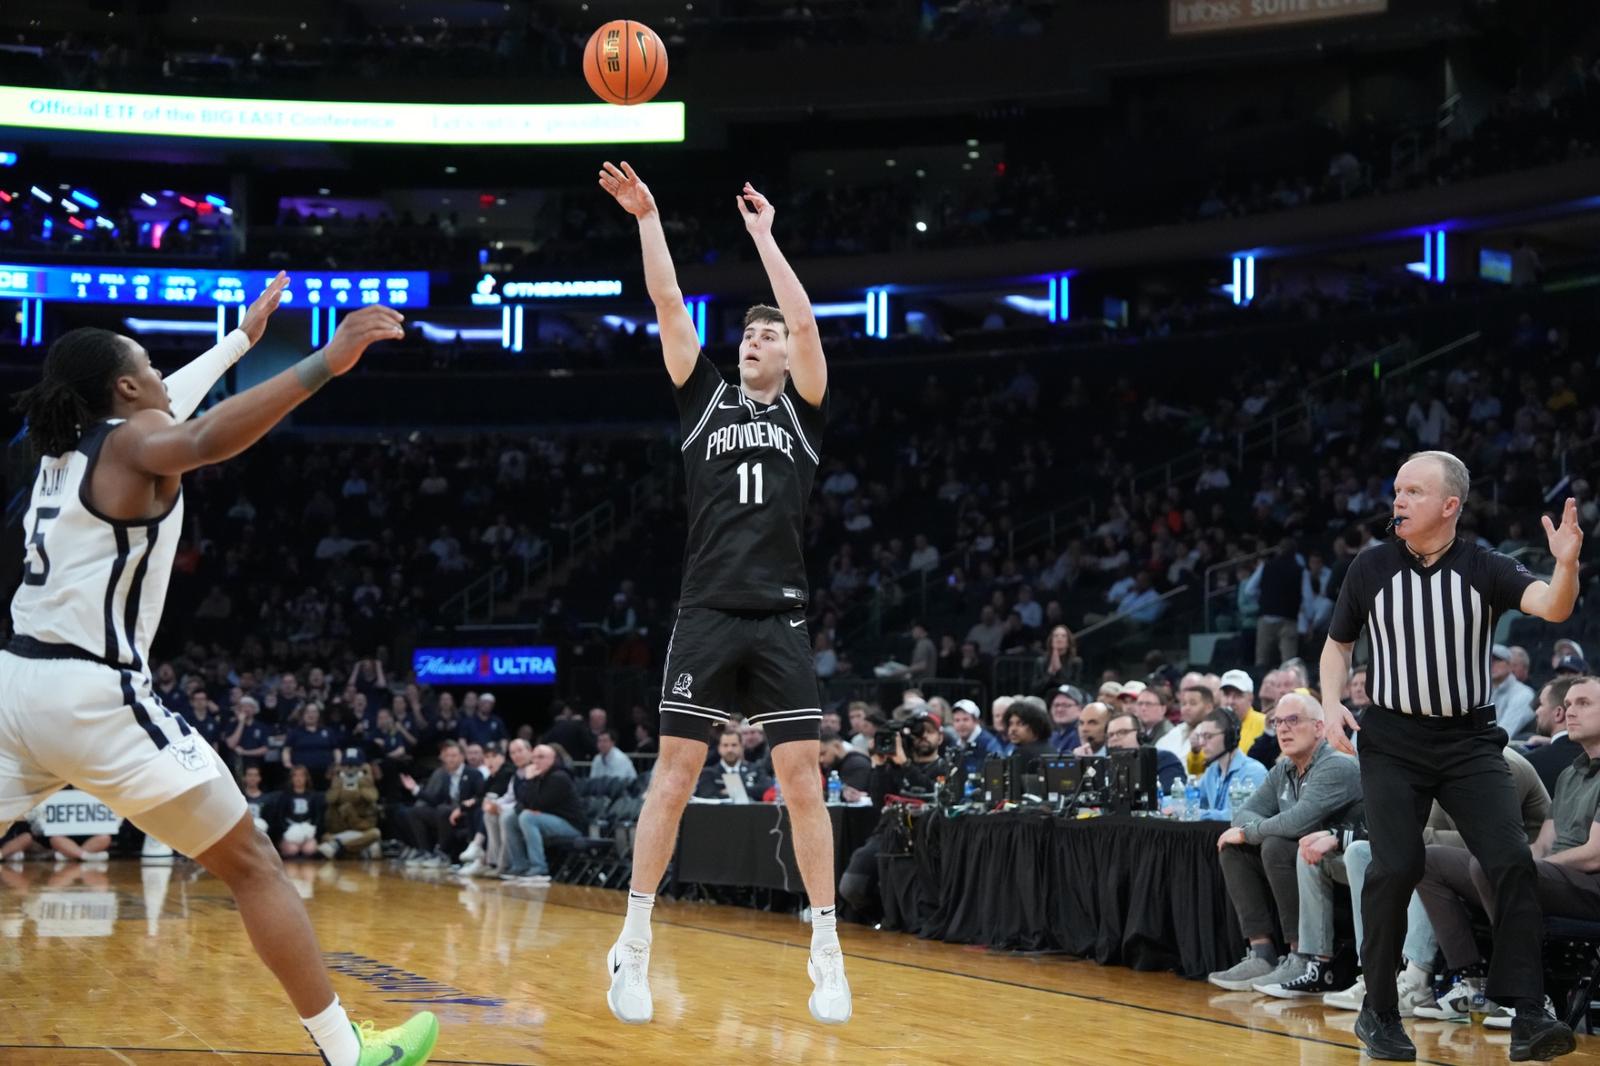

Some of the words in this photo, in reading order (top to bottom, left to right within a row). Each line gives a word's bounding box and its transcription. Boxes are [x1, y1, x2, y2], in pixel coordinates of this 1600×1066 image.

[29, 98, 99, 117] Official
[143, 105, 161, 121] of
[165, 107, 195, 122] the
[201, 108, 233, 124] BIG
[290, 111, 396, 129] Conference
[706, 422, 795, 463] PROVIDENCE
[737, 462, 763, 504] 11
[24, 507, 60, 586] 5
[493, 656, 556, 675] ULTRA
